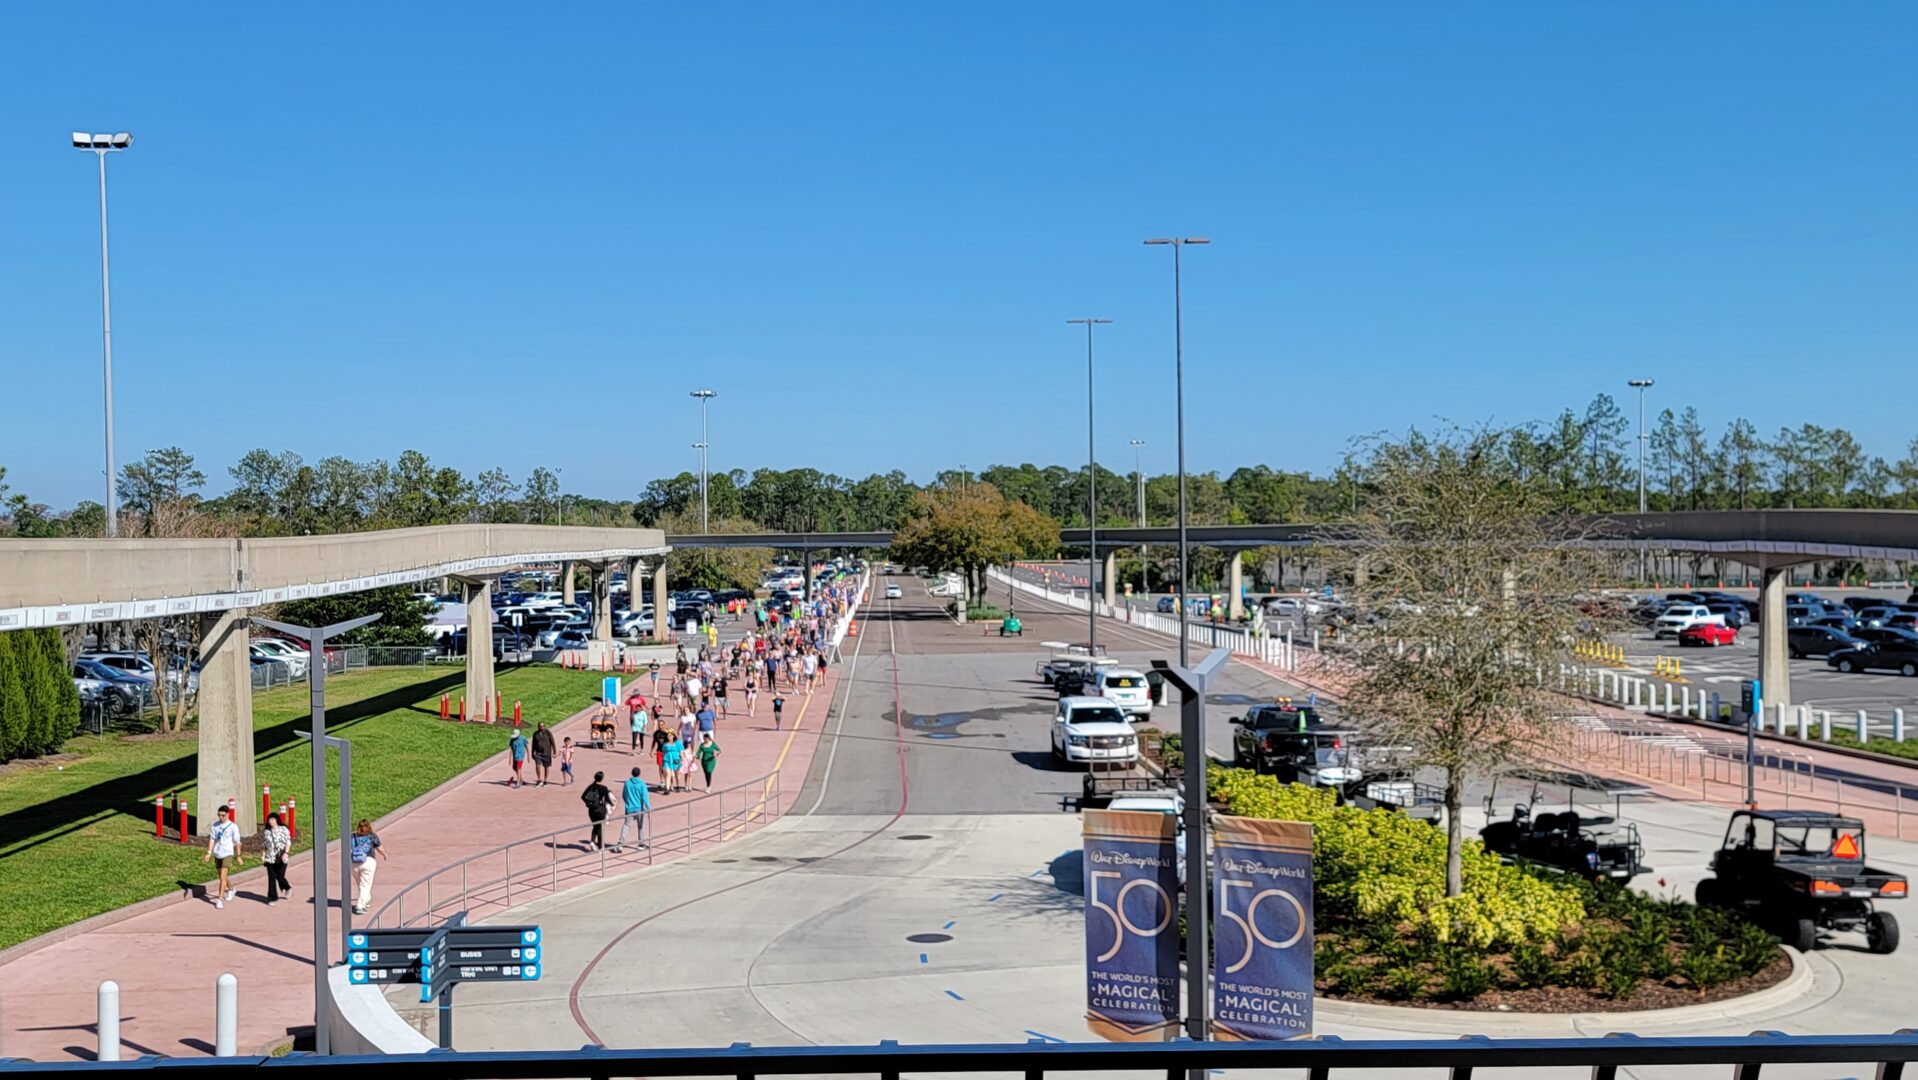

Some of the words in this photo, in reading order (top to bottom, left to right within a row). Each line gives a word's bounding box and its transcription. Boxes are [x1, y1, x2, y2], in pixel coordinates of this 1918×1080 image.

[1091, 850, 1112, 864] Walt
[1109, 851, 1146, 869] Disney
[1146, 857, 1171, 868] World
[1221, 857, 1243, 873] Walt
[1240, 859, 1279, 879] Disney
[1279, 866, 1306, 879] World
[1091, 870, 1172, 962] 50
[1221, 879, 1306, 974] 50
[1092, 971, 1108, 980] THE
[1109, 973, 1149, 984] WORLD'S
[1150, 976, 1174, 986] MOST
[1097, 983, 1169, 1001] MAGICAL
[1219, 982, 1236, 992] THE
[1238, 985, 1280, 997] WORLD'S
[1281, 990, 1307, 1000] MOST
[1093, 998, 1174, 1013] CELEBRATION
[1225, 994, 1302, 1017] MAGICAL
[1219, 1010, 1306, 1028] CELEBRATION
